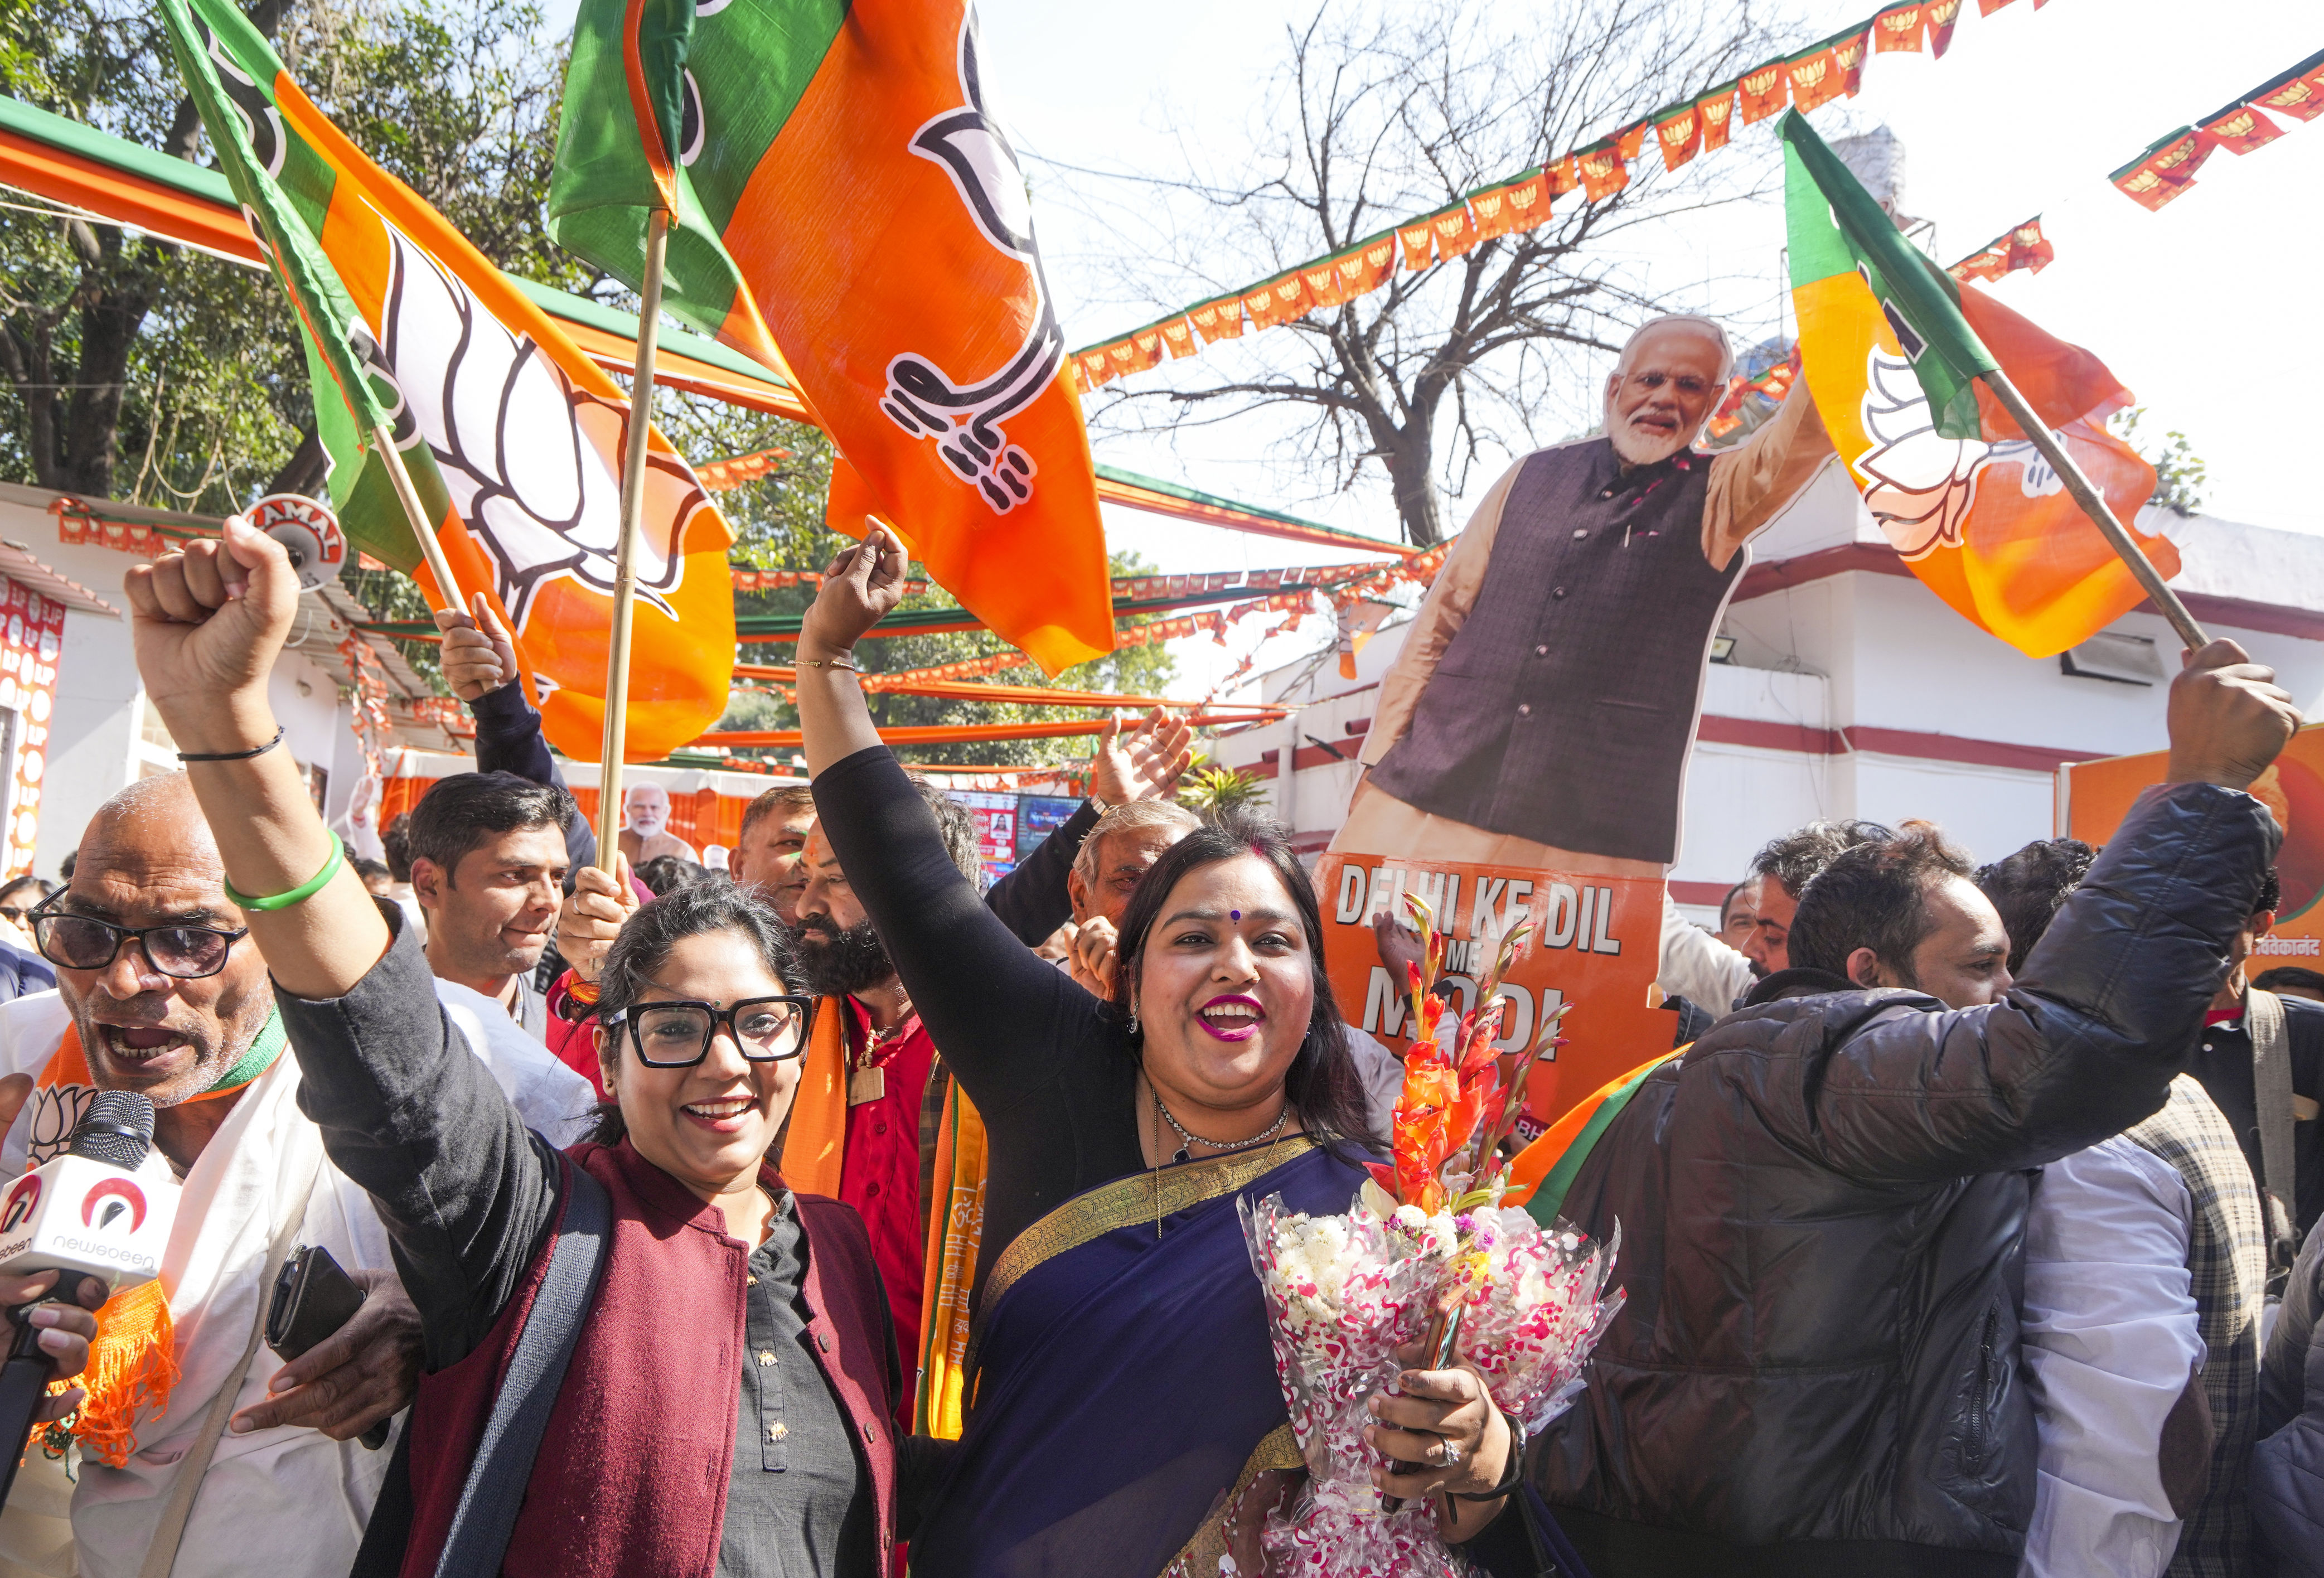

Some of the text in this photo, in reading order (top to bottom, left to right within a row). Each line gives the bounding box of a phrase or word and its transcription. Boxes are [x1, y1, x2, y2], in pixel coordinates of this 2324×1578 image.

[42, 603, 64, 625] BJP
[1336, 864, 1621, 956] DELHI KE DIL
[1445, 939, 1483, 975] ME
